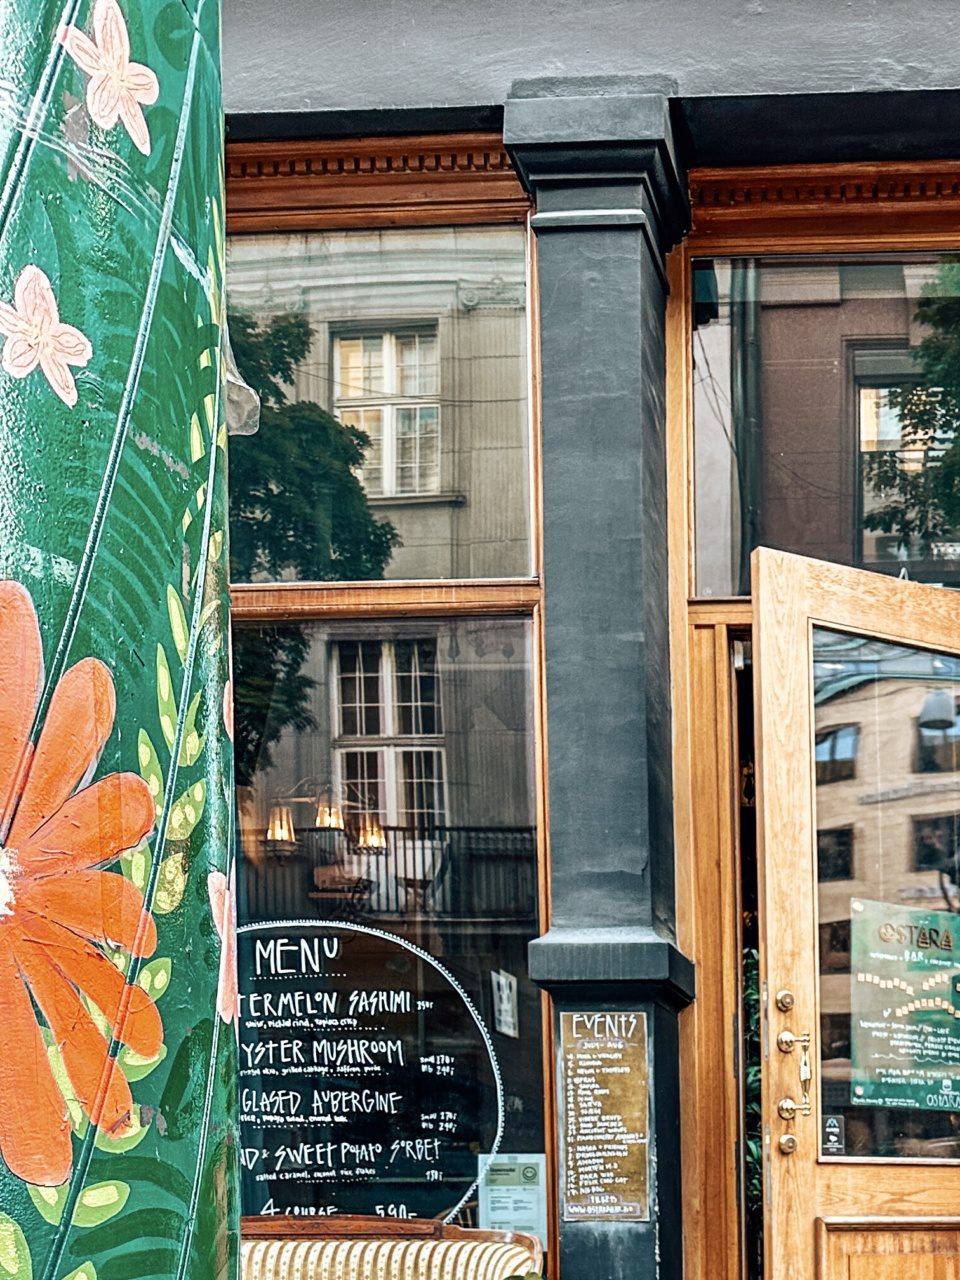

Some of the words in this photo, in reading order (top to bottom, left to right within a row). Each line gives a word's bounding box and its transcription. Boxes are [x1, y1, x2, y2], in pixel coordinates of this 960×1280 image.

[879, 923, 953, 951] OSTARA
[255, 938, 338, 975] MENU
[349, 990, 411, 1016] SASHIMI
[572, 1014, 638, 1038] EVENTS
[313, 1039, 404, 1066] MUSHROOM
[312, 1089, 403, 1115] AUBERGINE
[275, 1142, 337, 1171] SWEET
[390, 1138, 442, 1164] SORBET
[260, 1198, 280, 1216] 4
